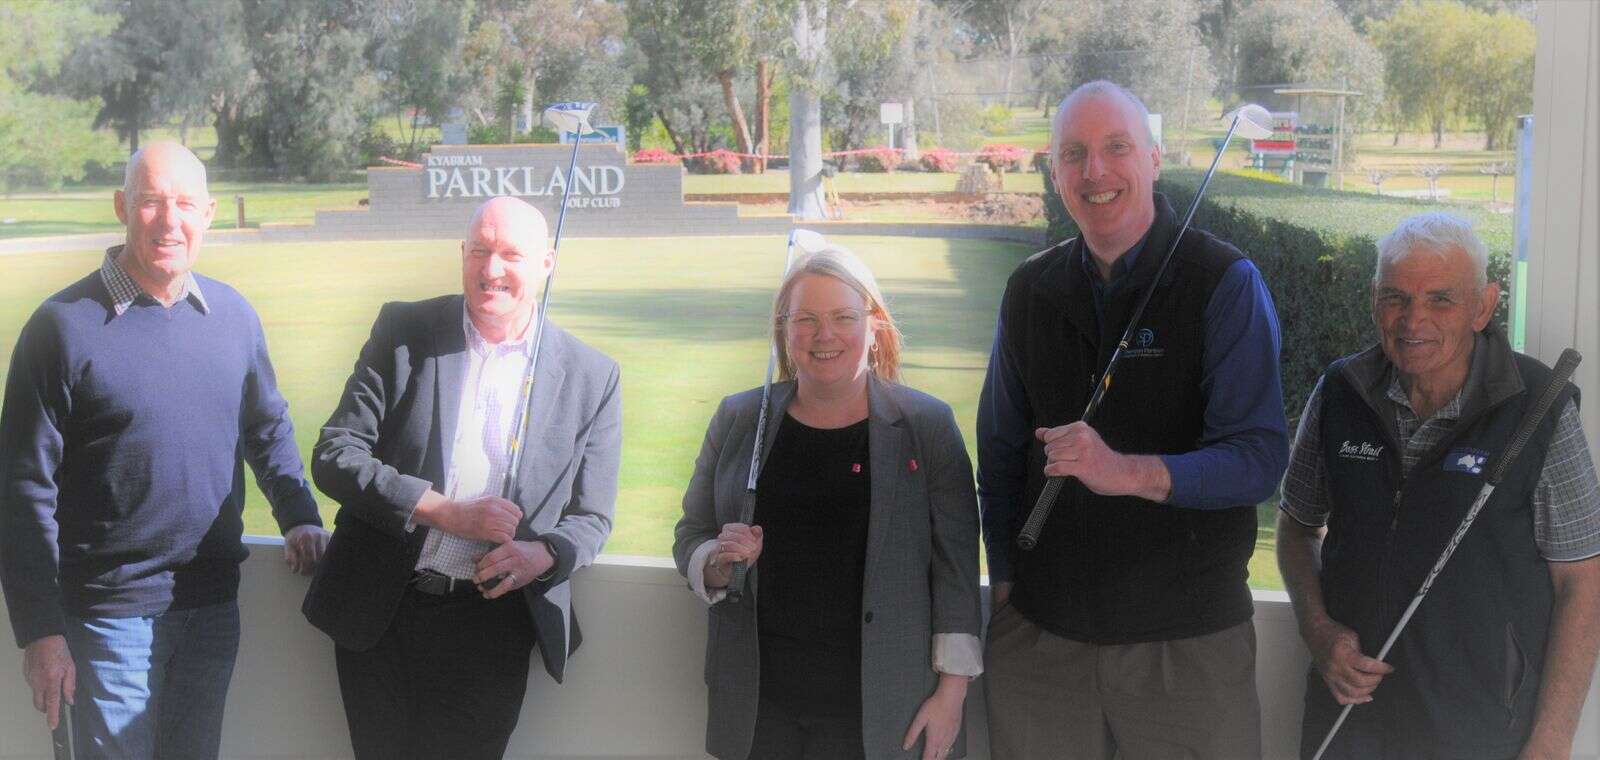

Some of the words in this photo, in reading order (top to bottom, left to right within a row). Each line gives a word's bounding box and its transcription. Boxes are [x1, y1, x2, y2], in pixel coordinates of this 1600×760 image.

[428, 155, 482, 166] KYABRAM
[427, 165, 624, 198] PARKLAND
[591, 197, 620, 208] CLUB
